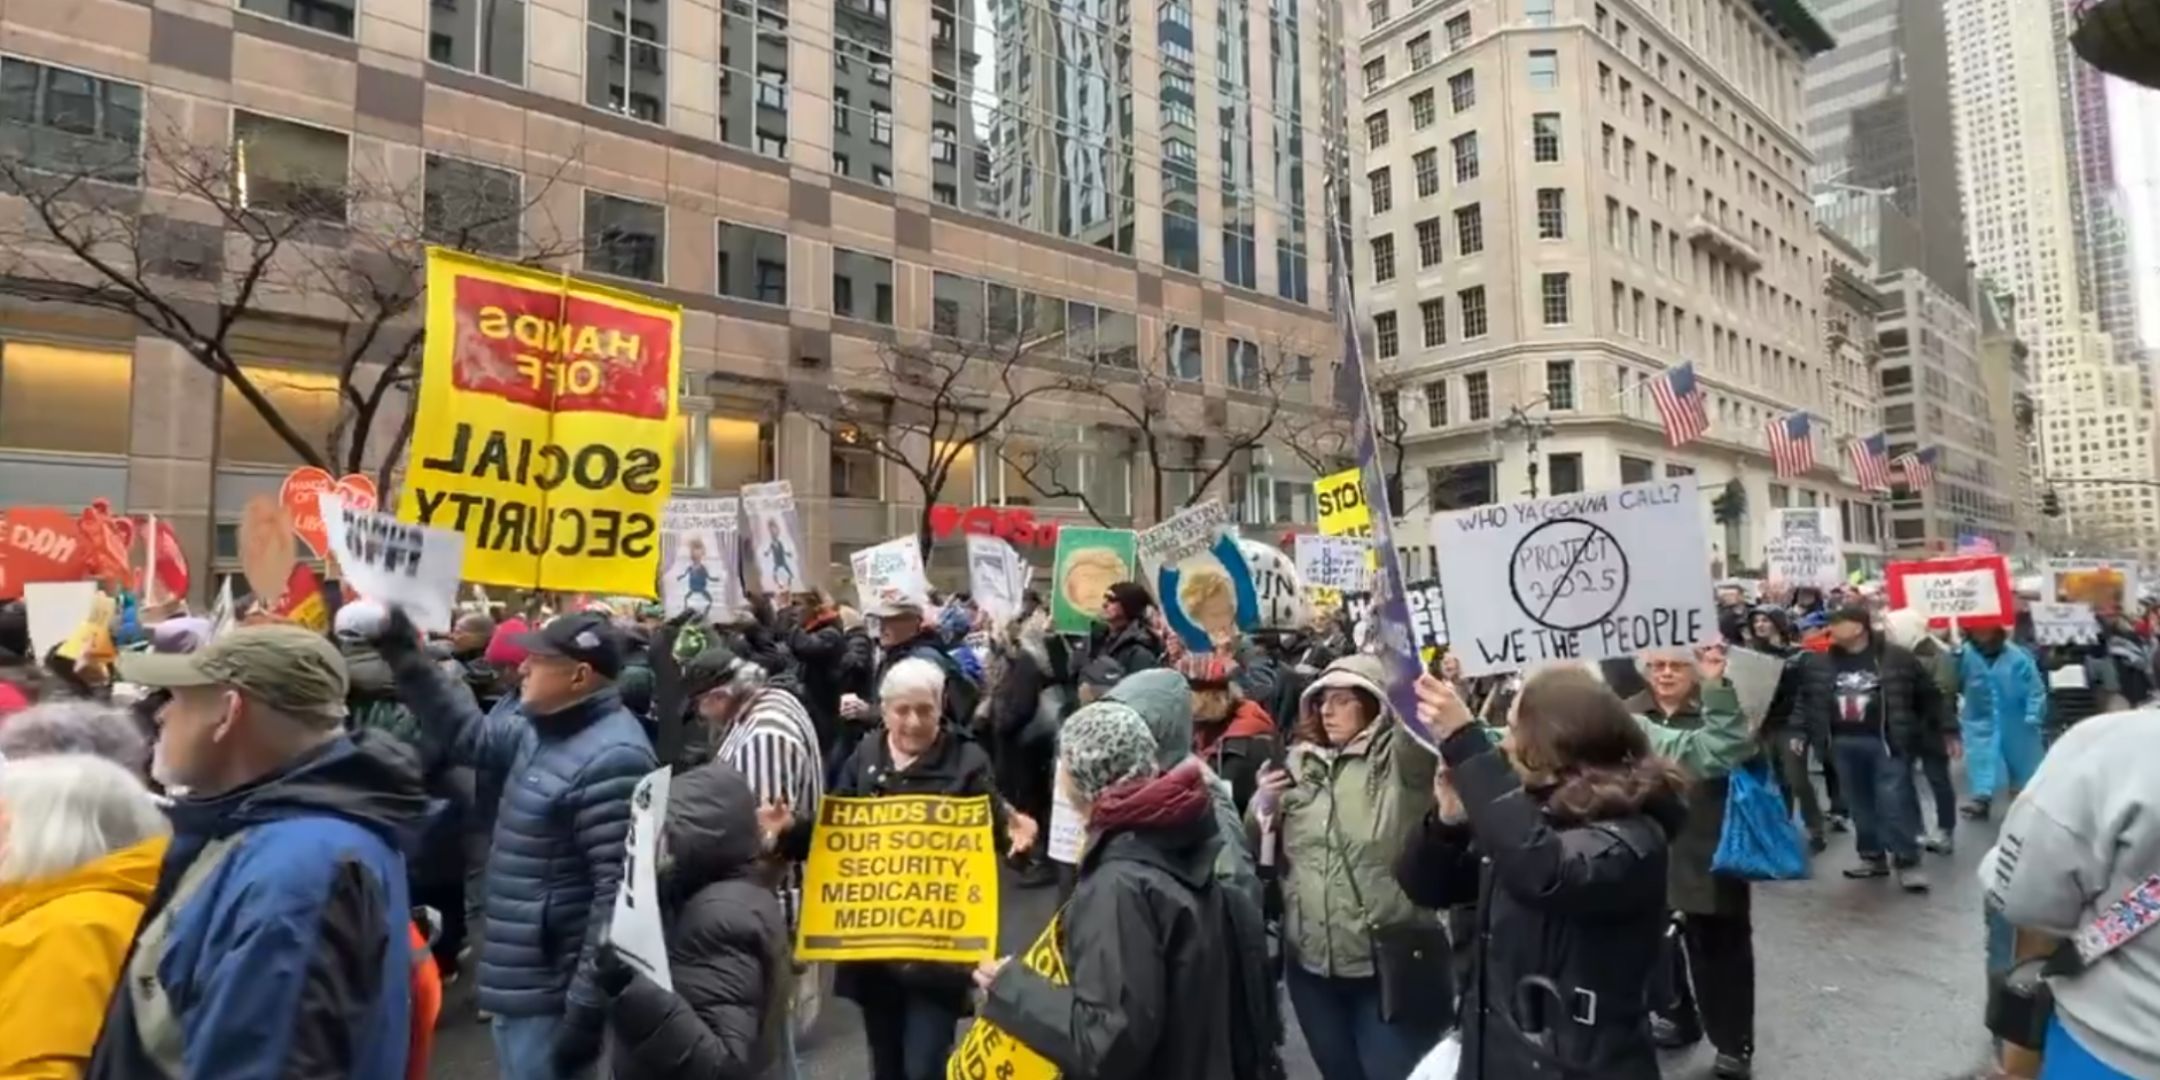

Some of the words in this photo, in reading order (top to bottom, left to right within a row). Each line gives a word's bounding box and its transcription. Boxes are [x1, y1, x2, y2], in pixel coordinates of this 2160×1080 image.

[1457, 507, 1508, 532] WHO
[1516, 503, 1540, 525] YA
[1540, 494, 1608, 520] GONNA
[1619, 483, 1682, 511] CALL?
[1519, 536, 1609, 572] PROJECT
[1530, 567, 1618, 599] 2025
[1476, 628, 1526, 665] WE
[1532, 629, 1580, 660] THE
[1601, 608, 1702, 654] PEOPLE
[831, 802, 927, 825] HANDS
[935, 803, 985, 825] OFF
[826, 831, 882, 852] OUR
[888, 831, 983, 852] SOCIAL
[838, 856, 971, 879] SECURITY,
[821, 882, 958, 904] MEDICARE
[967, 885, 982, 904] &
[834, 907, 966, 930] MEDICAID
